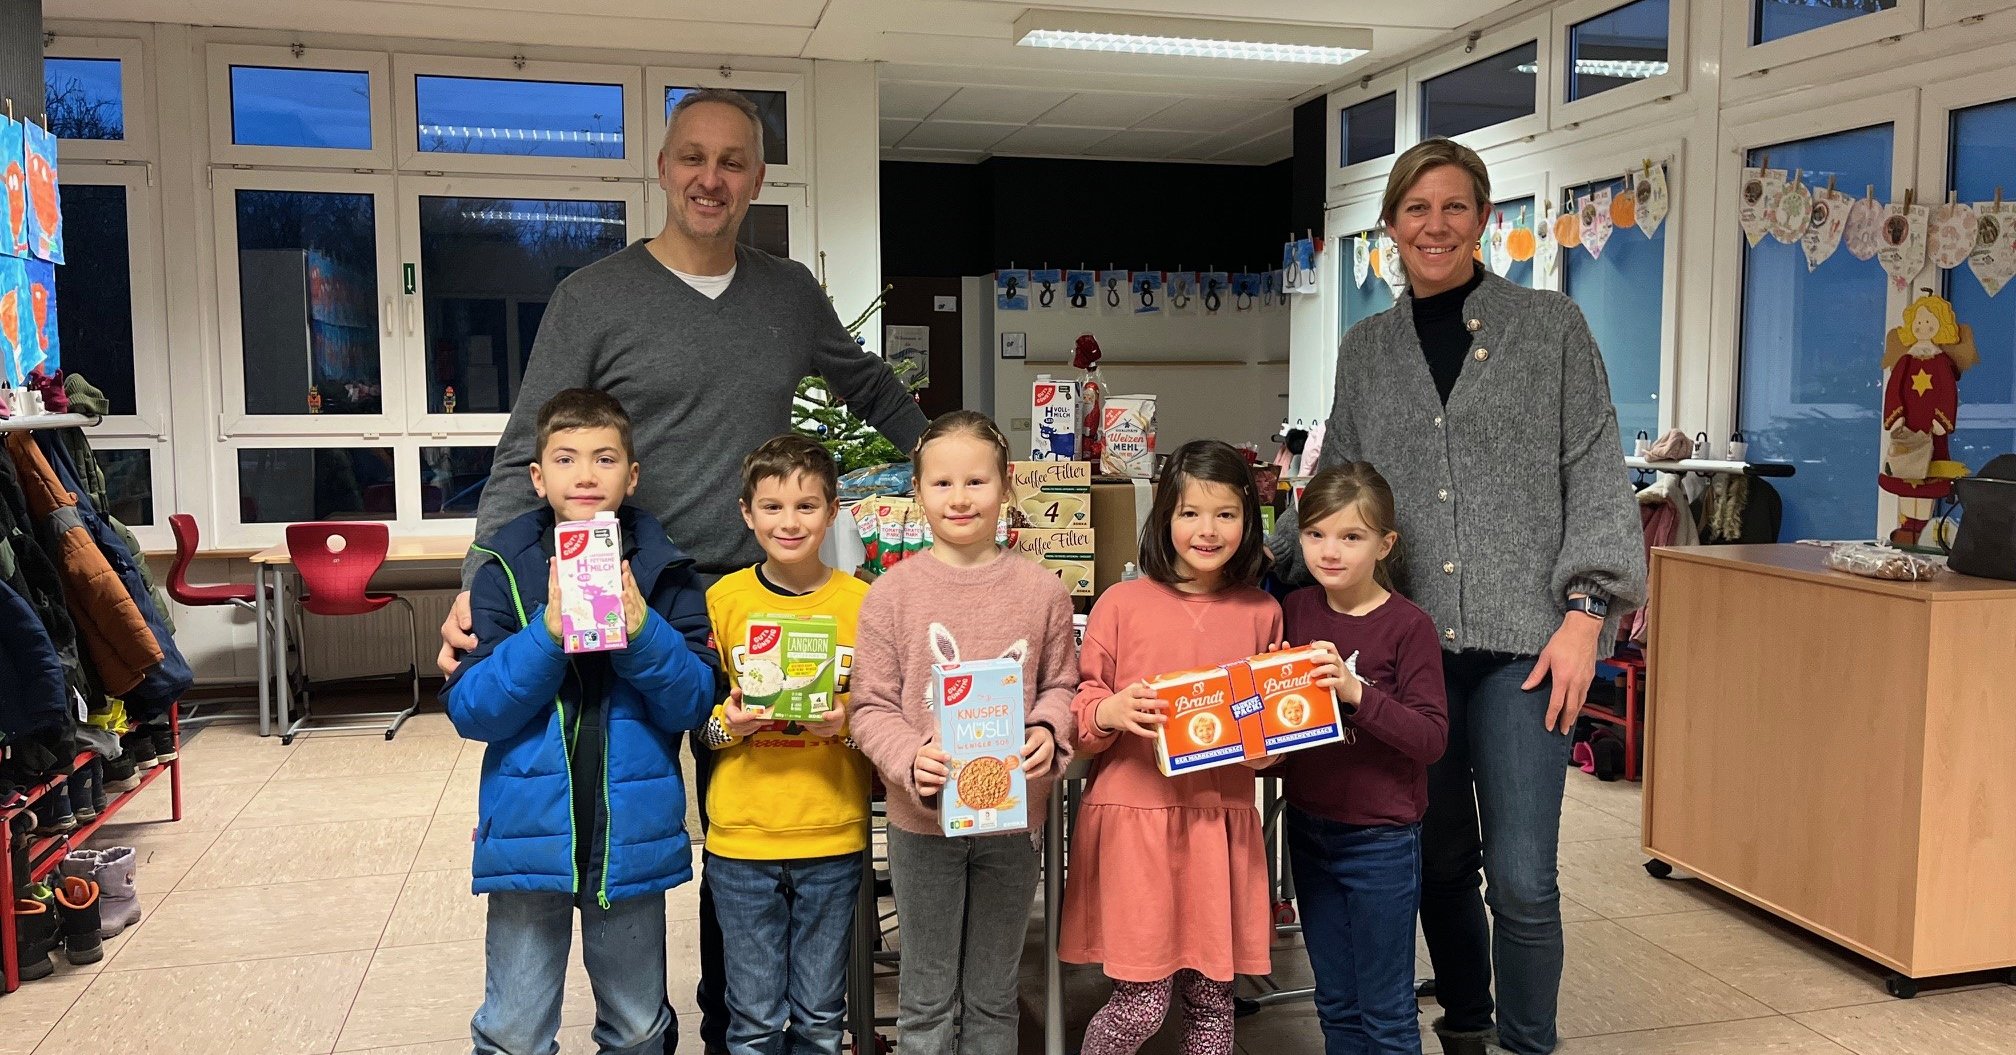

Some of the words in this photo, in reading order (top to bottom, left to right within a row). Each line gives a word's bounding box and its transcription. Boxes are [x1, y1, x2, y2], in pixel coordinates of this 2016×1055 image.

[1045, 406, 1053, 417] H
[1108, 433, 1144, 443] Weizen
[1113, 443, 1139, 451] MEHL
[1015, 470, 1048, 489] Kaffee
[1047, 463, 1086, 481] Filter
[1044, 501, 1059, 523] 4
[1019, 537, 1052, 556] Kaffee
[1051, 530, 1089, 548] Filter
[577, 559, 588, 573] H
[590, 563, 615, 573] MILCH
[787, 637, 829, 653] LANGKORN
[1263, 673, 1311, 695] Brandt
[1174, 690, 1225, 713] Brandt
[957, 704, 1009, 720] KNUSPER
[957, 719, 1009, 741] MÜSLI
